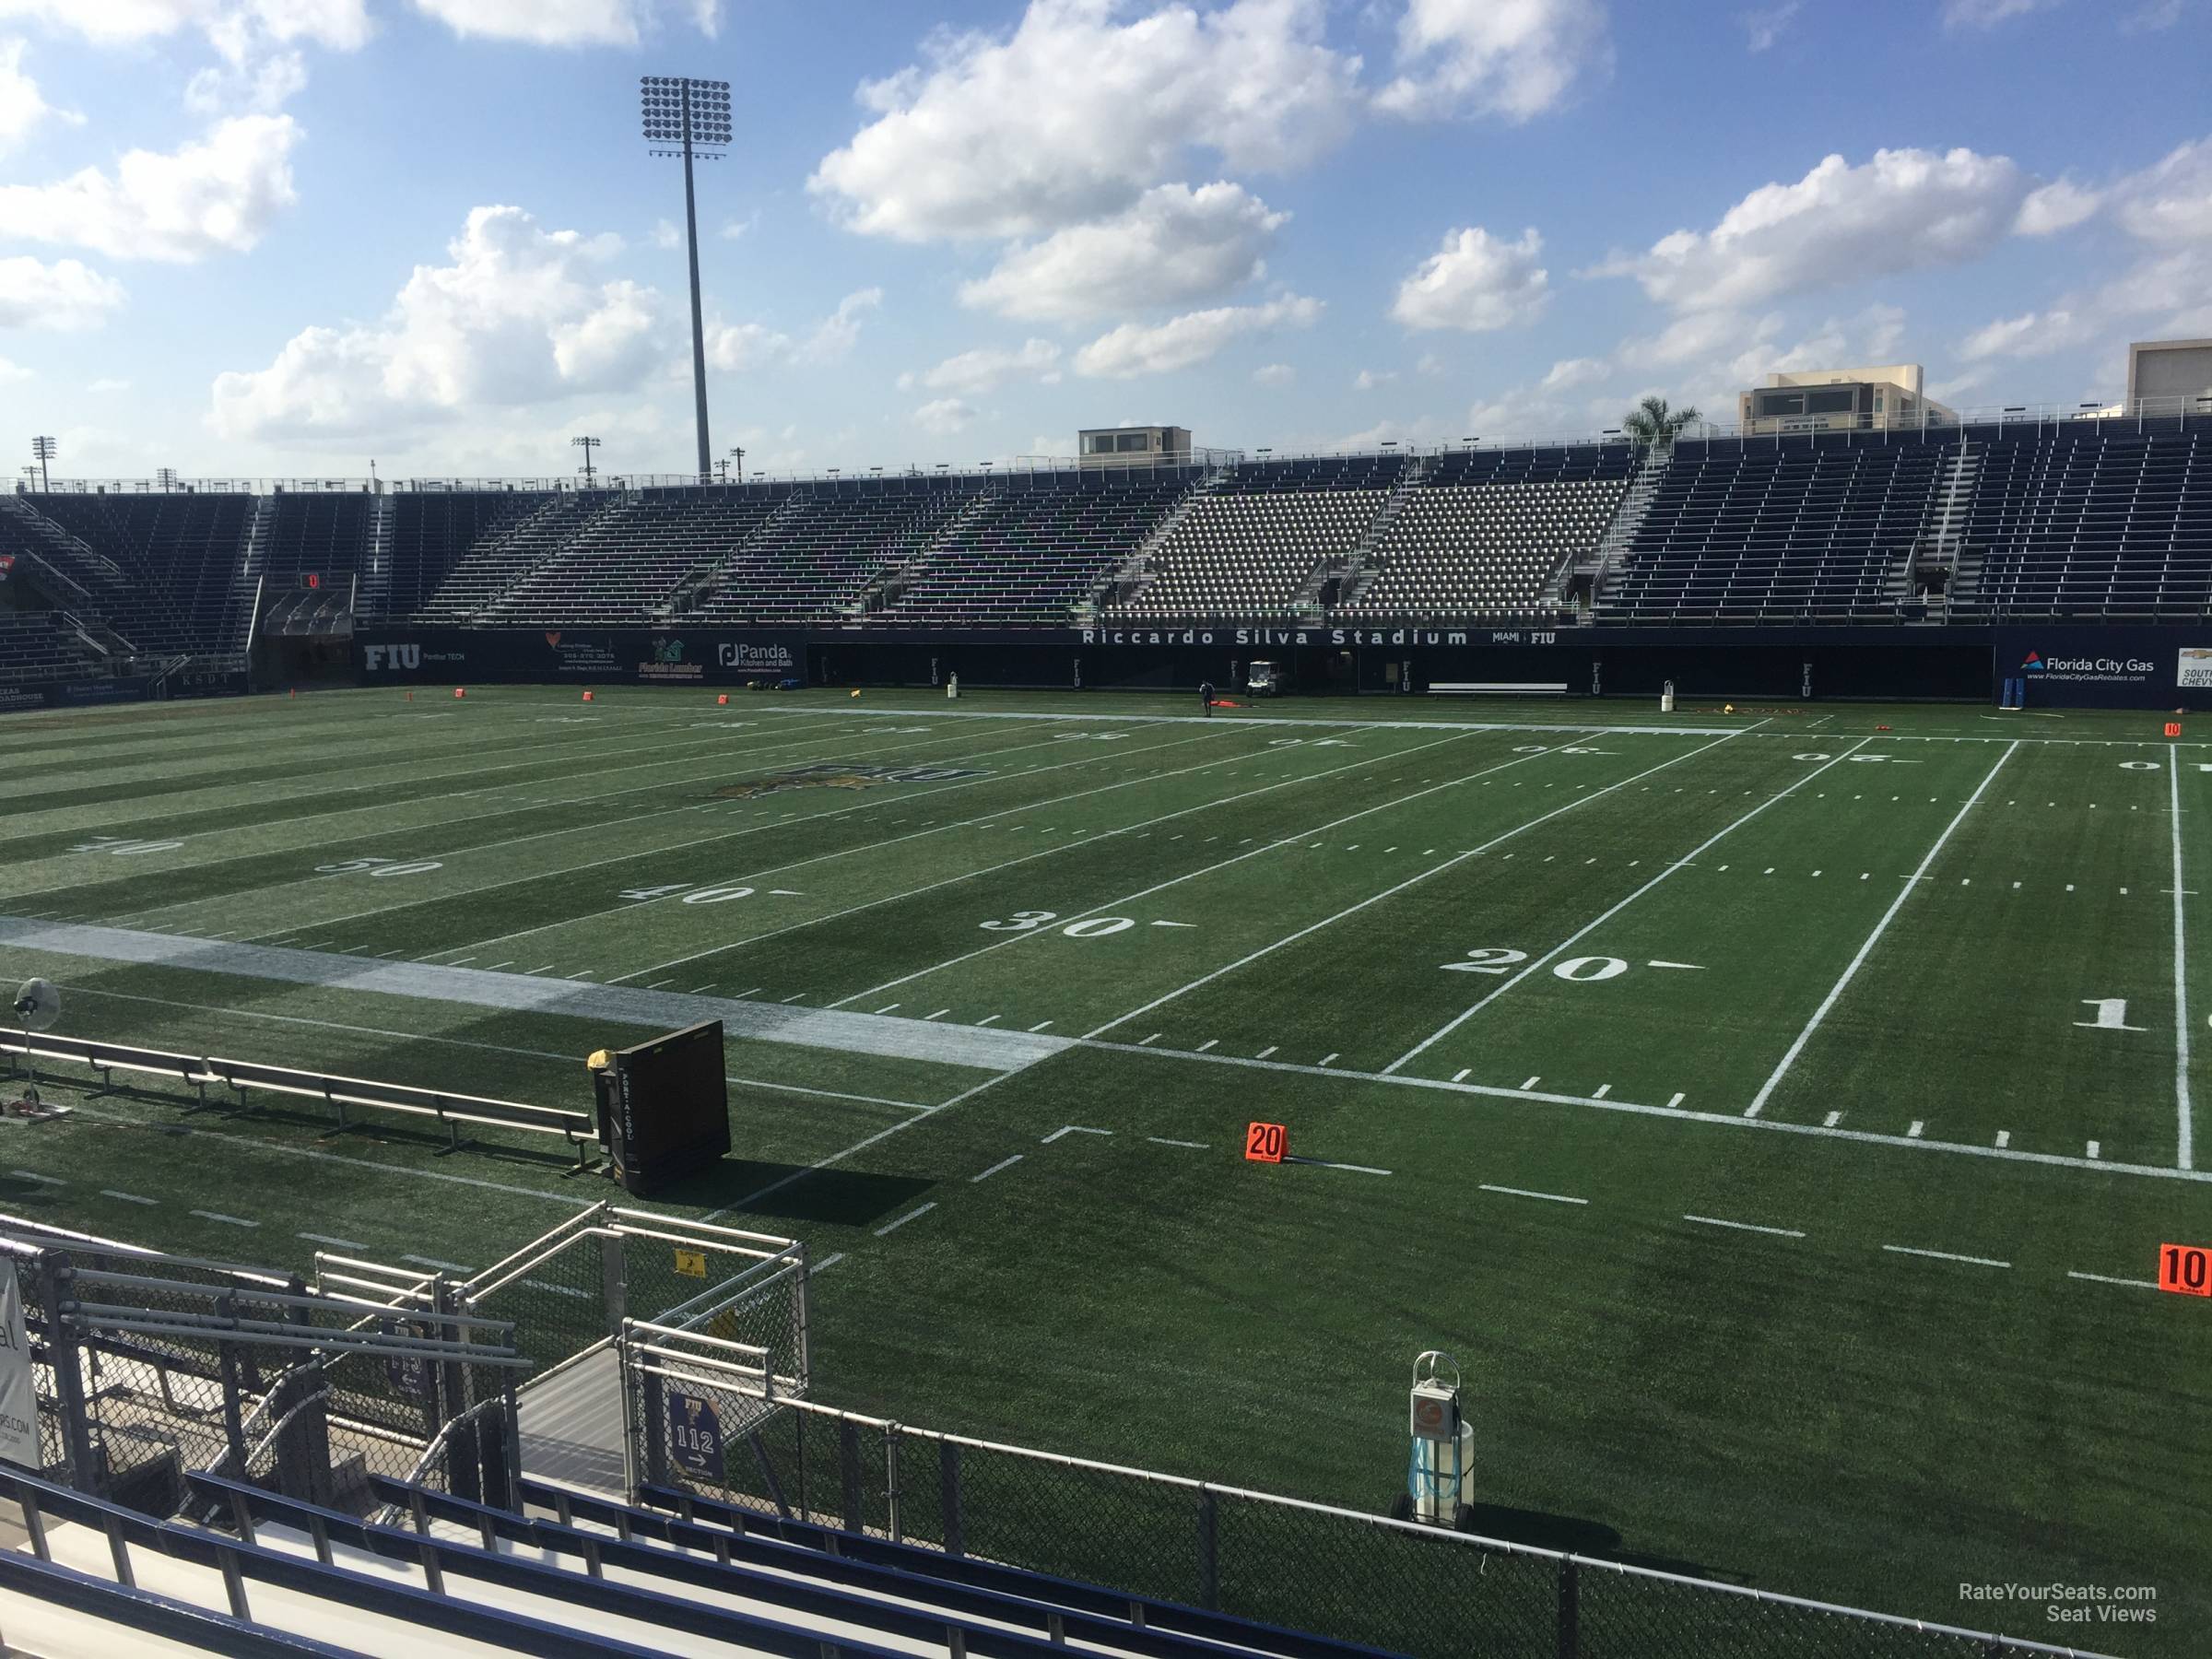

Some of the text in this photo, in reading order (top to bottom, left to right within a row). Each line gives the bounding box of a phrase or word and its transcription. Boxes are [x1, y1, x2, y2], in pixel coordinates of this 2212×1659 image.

[1082, 629, 1467, 645] Riccardo Silva Stadium
[1492, 631, 1556, 644] MIAMI FIU
[364, 644, 420, 670] FIU
[739, 643, 787, 659] Panda
[1403, 661, 1411, 692] FIU
[1593, 662, 1602, 695] FIU
[2047, 657, 2154, 674] Florida City Gas
[1803, 663, 1813, 698] FIU
[314, 857, 443, 877] 50
[618, 882, 754, 905] 40
[980, 911, 1135, 937] 30
[1440, 947, 1628, 982] 20
[1251, 1125, 1280, 1156] 20
[2166, 1248, 2206, 1288] 10
[685, 1398, 701, 1412] FIU
[677, 1425, 714, 1454] 112
